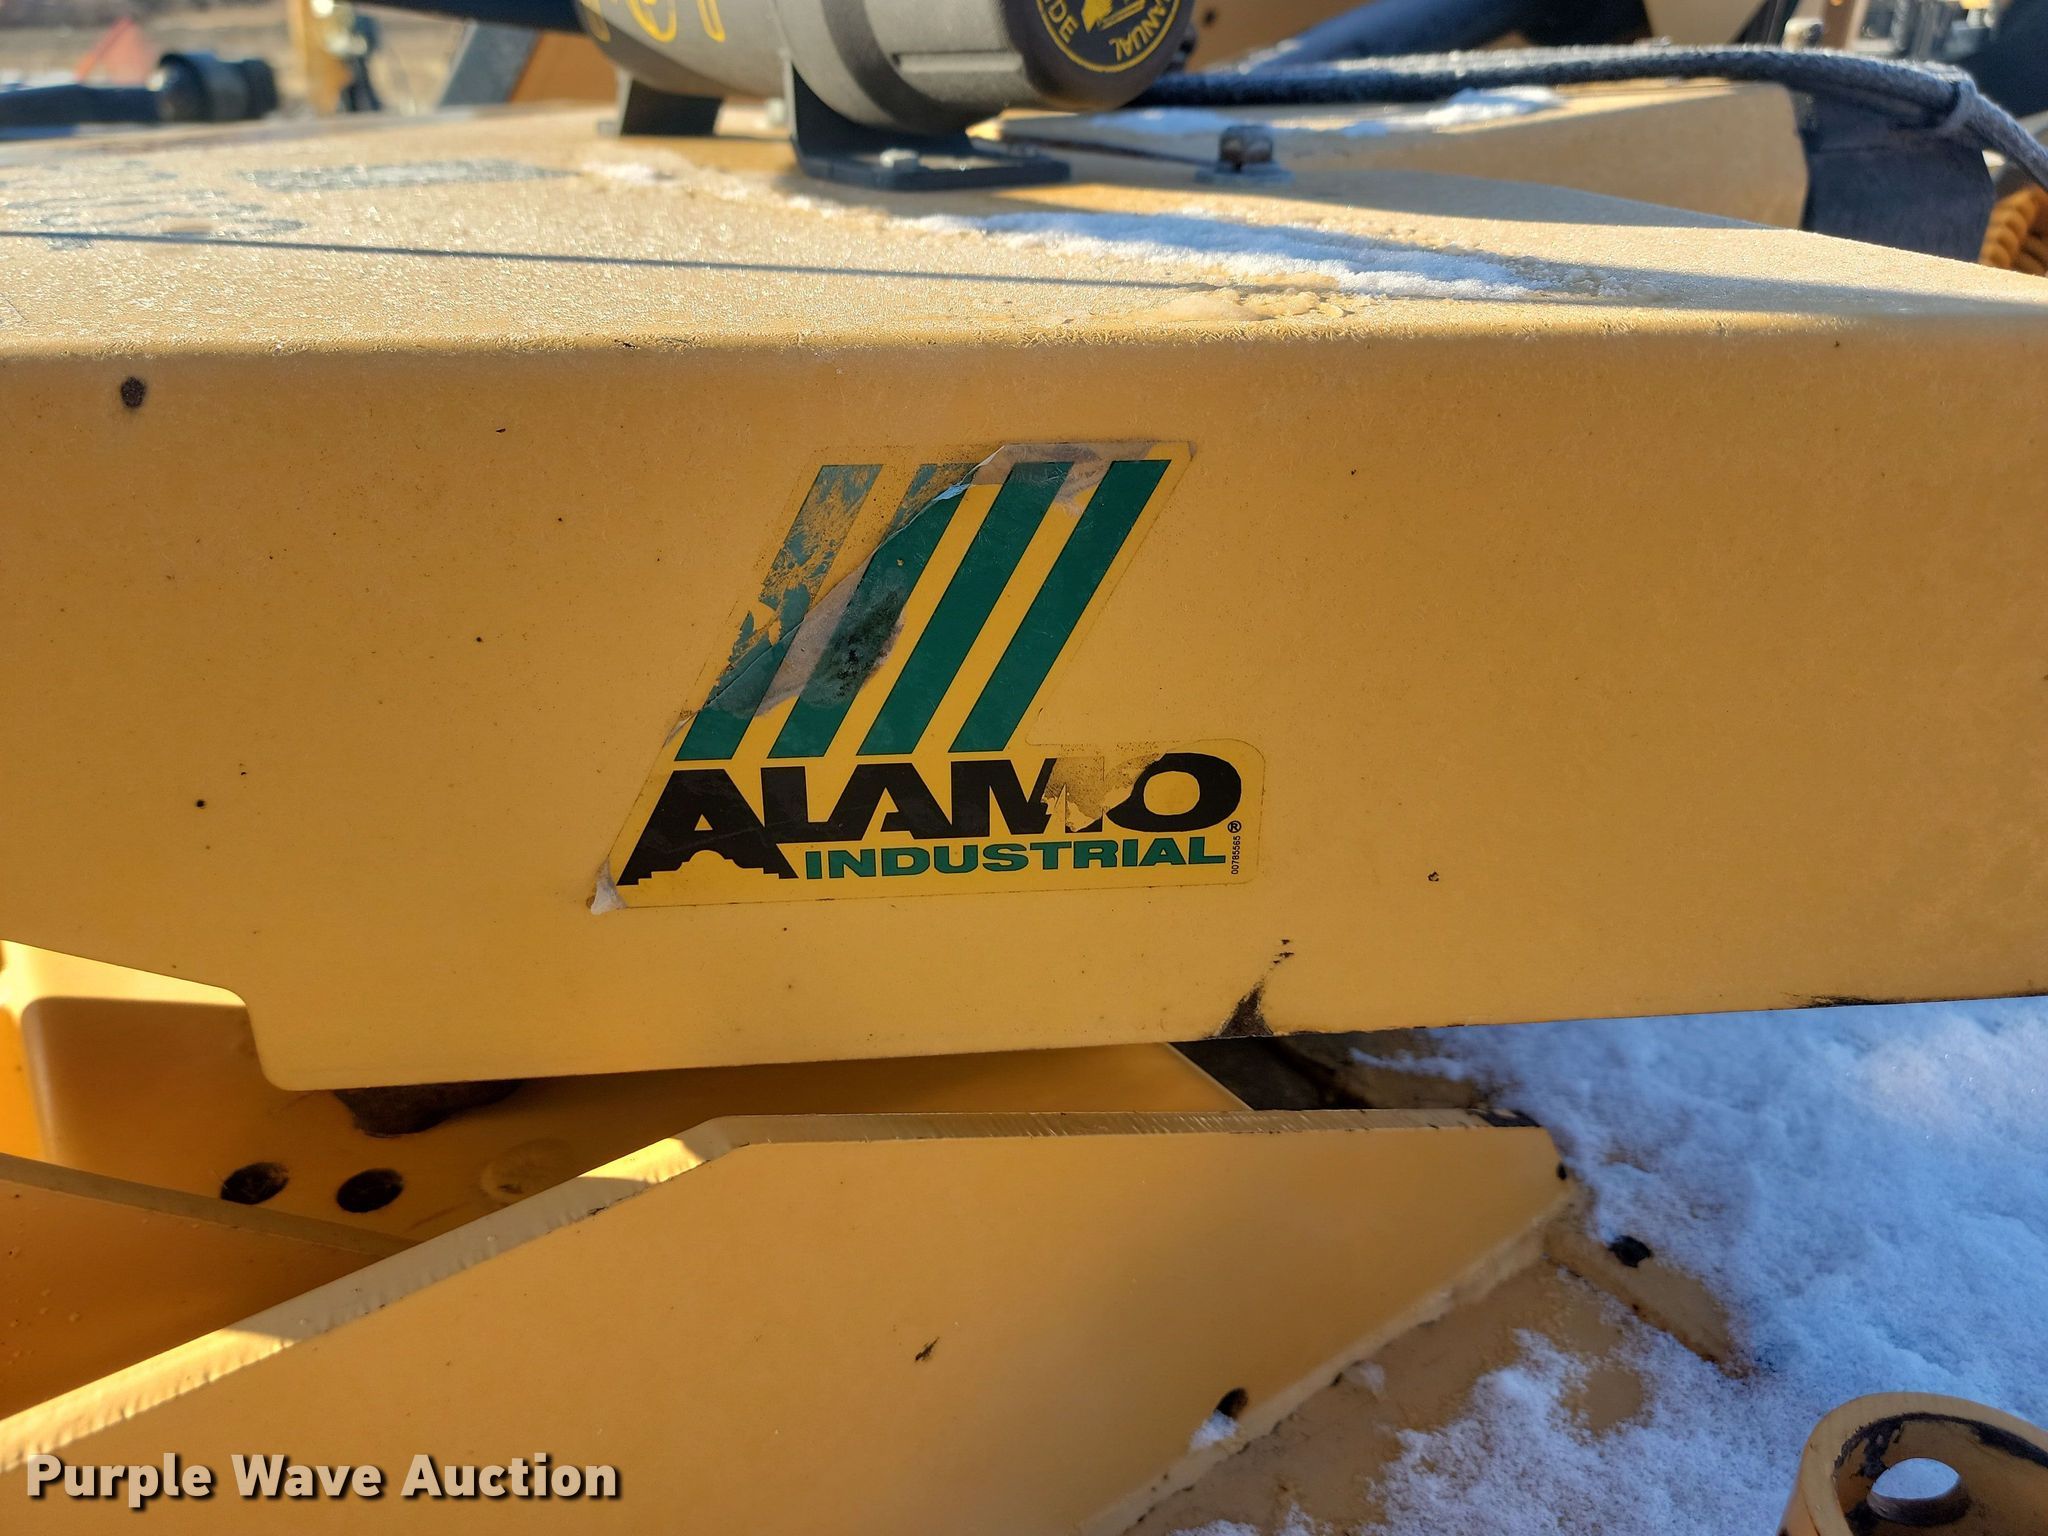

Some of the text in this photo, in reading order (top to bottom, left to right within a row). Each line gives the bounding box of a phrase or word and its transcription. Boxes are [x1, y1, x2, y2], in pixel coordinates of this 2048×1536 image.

[1045, 0, 1080, 44] DE
[1108, 0, 1169, 61] ANUAL
[616, 752, 1243, 886] ALAMO
[805, 836, 1226, 880] INDUSTRIAL
[1230, 835, 1241, 875] 00785565
